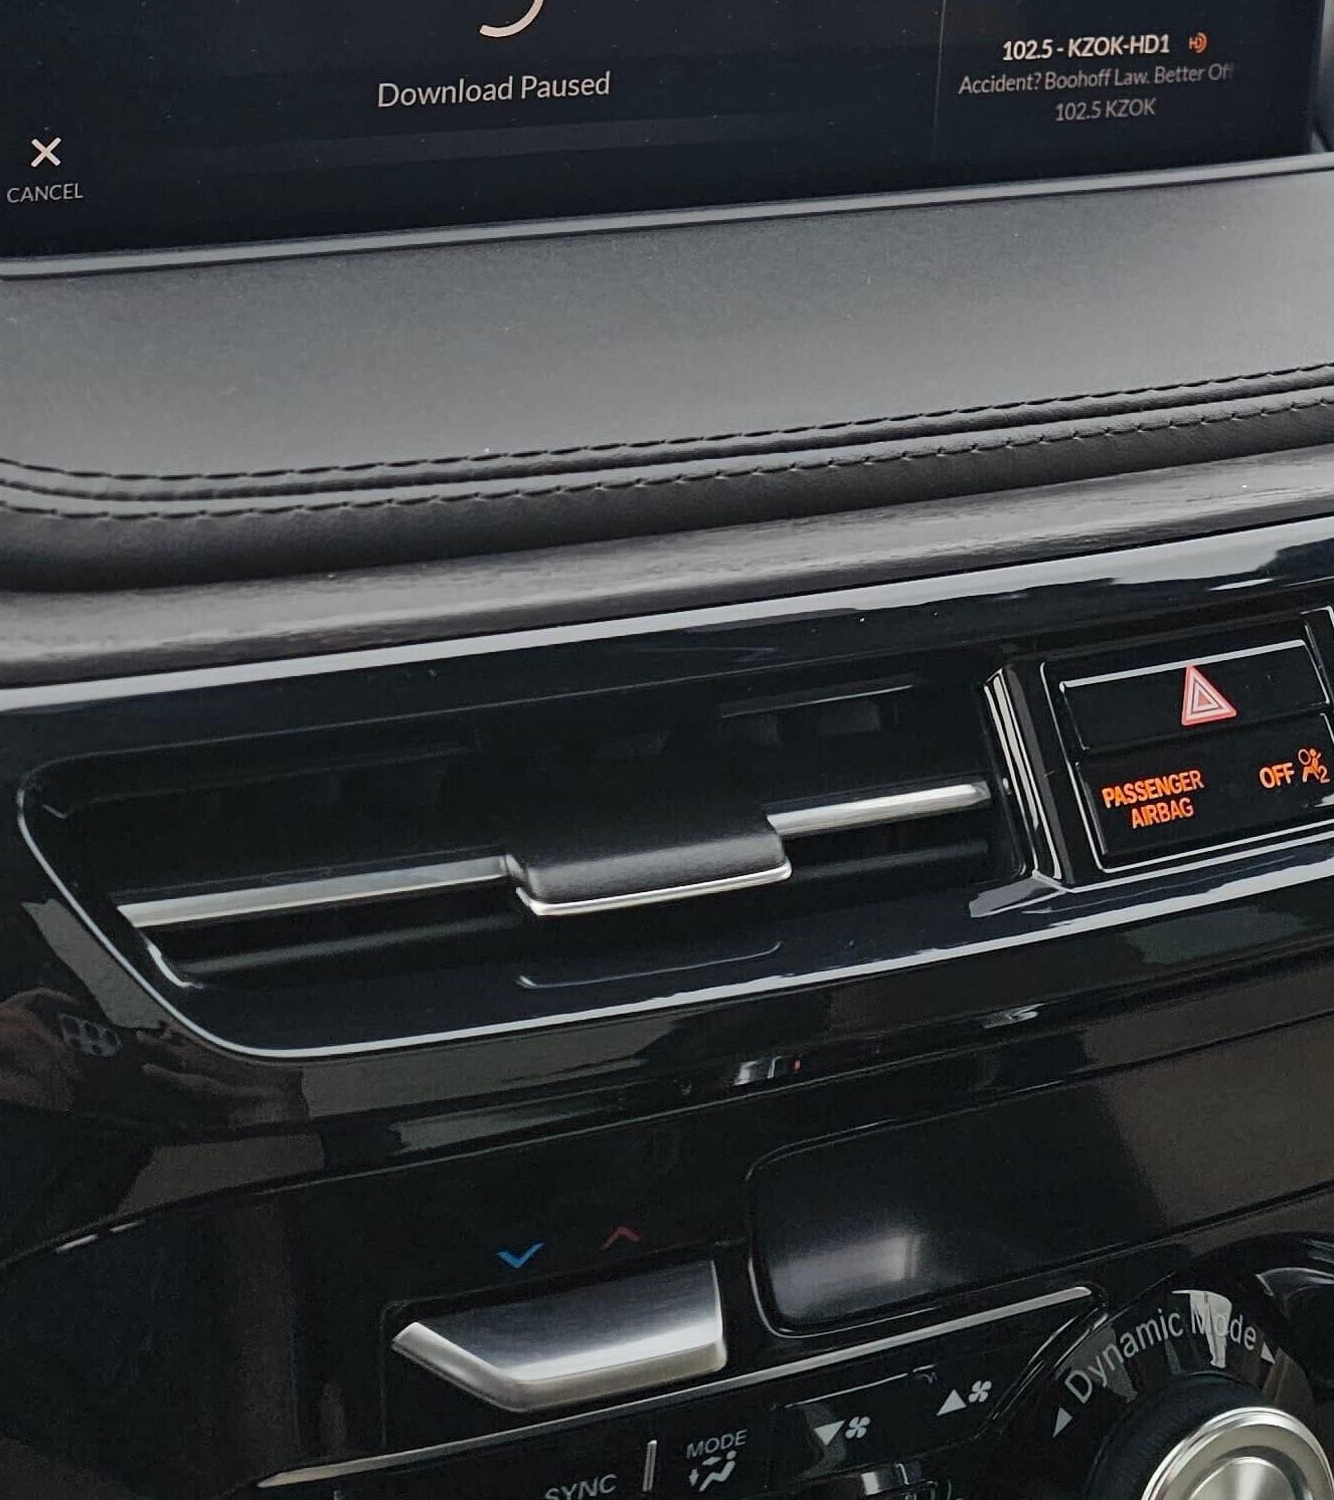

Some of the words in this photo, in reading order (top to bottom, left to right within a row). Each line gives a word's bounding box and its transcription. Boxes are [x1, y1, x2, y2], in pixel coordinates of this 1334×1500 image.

[1002, 39, 1053, 61] 102.5
[1068, 34, 1171, 58] KZOK-HD1
[378, 75, 513, 108] Download
[521, 70, 611, 99] Paused
[958, 72, 1042, 95] Accident?
[1045, 68, 1111, 91] Boohoff
[1114, 69, 1150, 88] Law.
[1154, 64, 1205, 84] Better
[1055, 102, 1102, 122] 102.5
[1105, 97, 1157, 119] KZOK
[6, 182, 84, 204] CANCEL
[1101, 769, 1205, 809] PASSENGER
[1258, 762, 1295, 789] OFF
[1130, 797, 1195, 829] AIRBAG
[1063, 1308, 1184, 1405] Dynamic
[685, 1429, 748, 1460] MODE
[543, 1473, 618, 1500] SYNC
